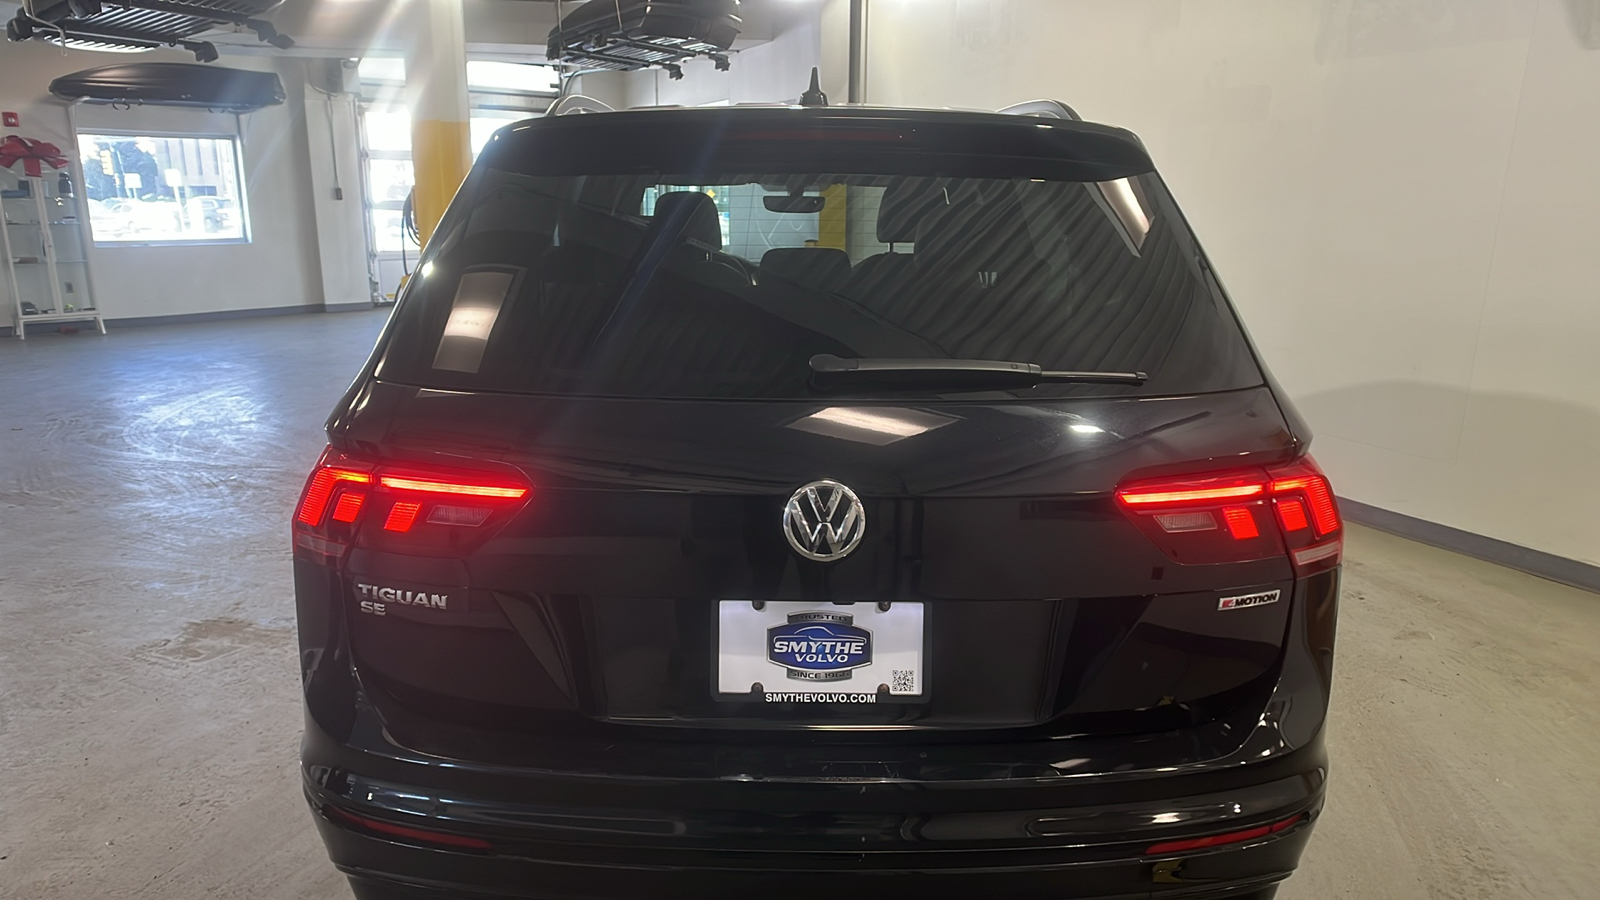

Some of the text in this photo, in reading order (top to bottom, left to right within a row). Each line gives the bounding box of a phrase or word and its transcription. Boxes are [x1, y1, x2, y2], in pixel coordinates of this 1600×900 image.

[358, 583, 447, 609] TIGUAN
[360, 600, 386, 616] SE
[774, 641, 864, 654] SMYTHE
[795, 654, 848, 663] VOLVO
[790, 670, 821, 679] SINCE
[765, 693, 876, 703] SMYTHEVOLVO.COM
